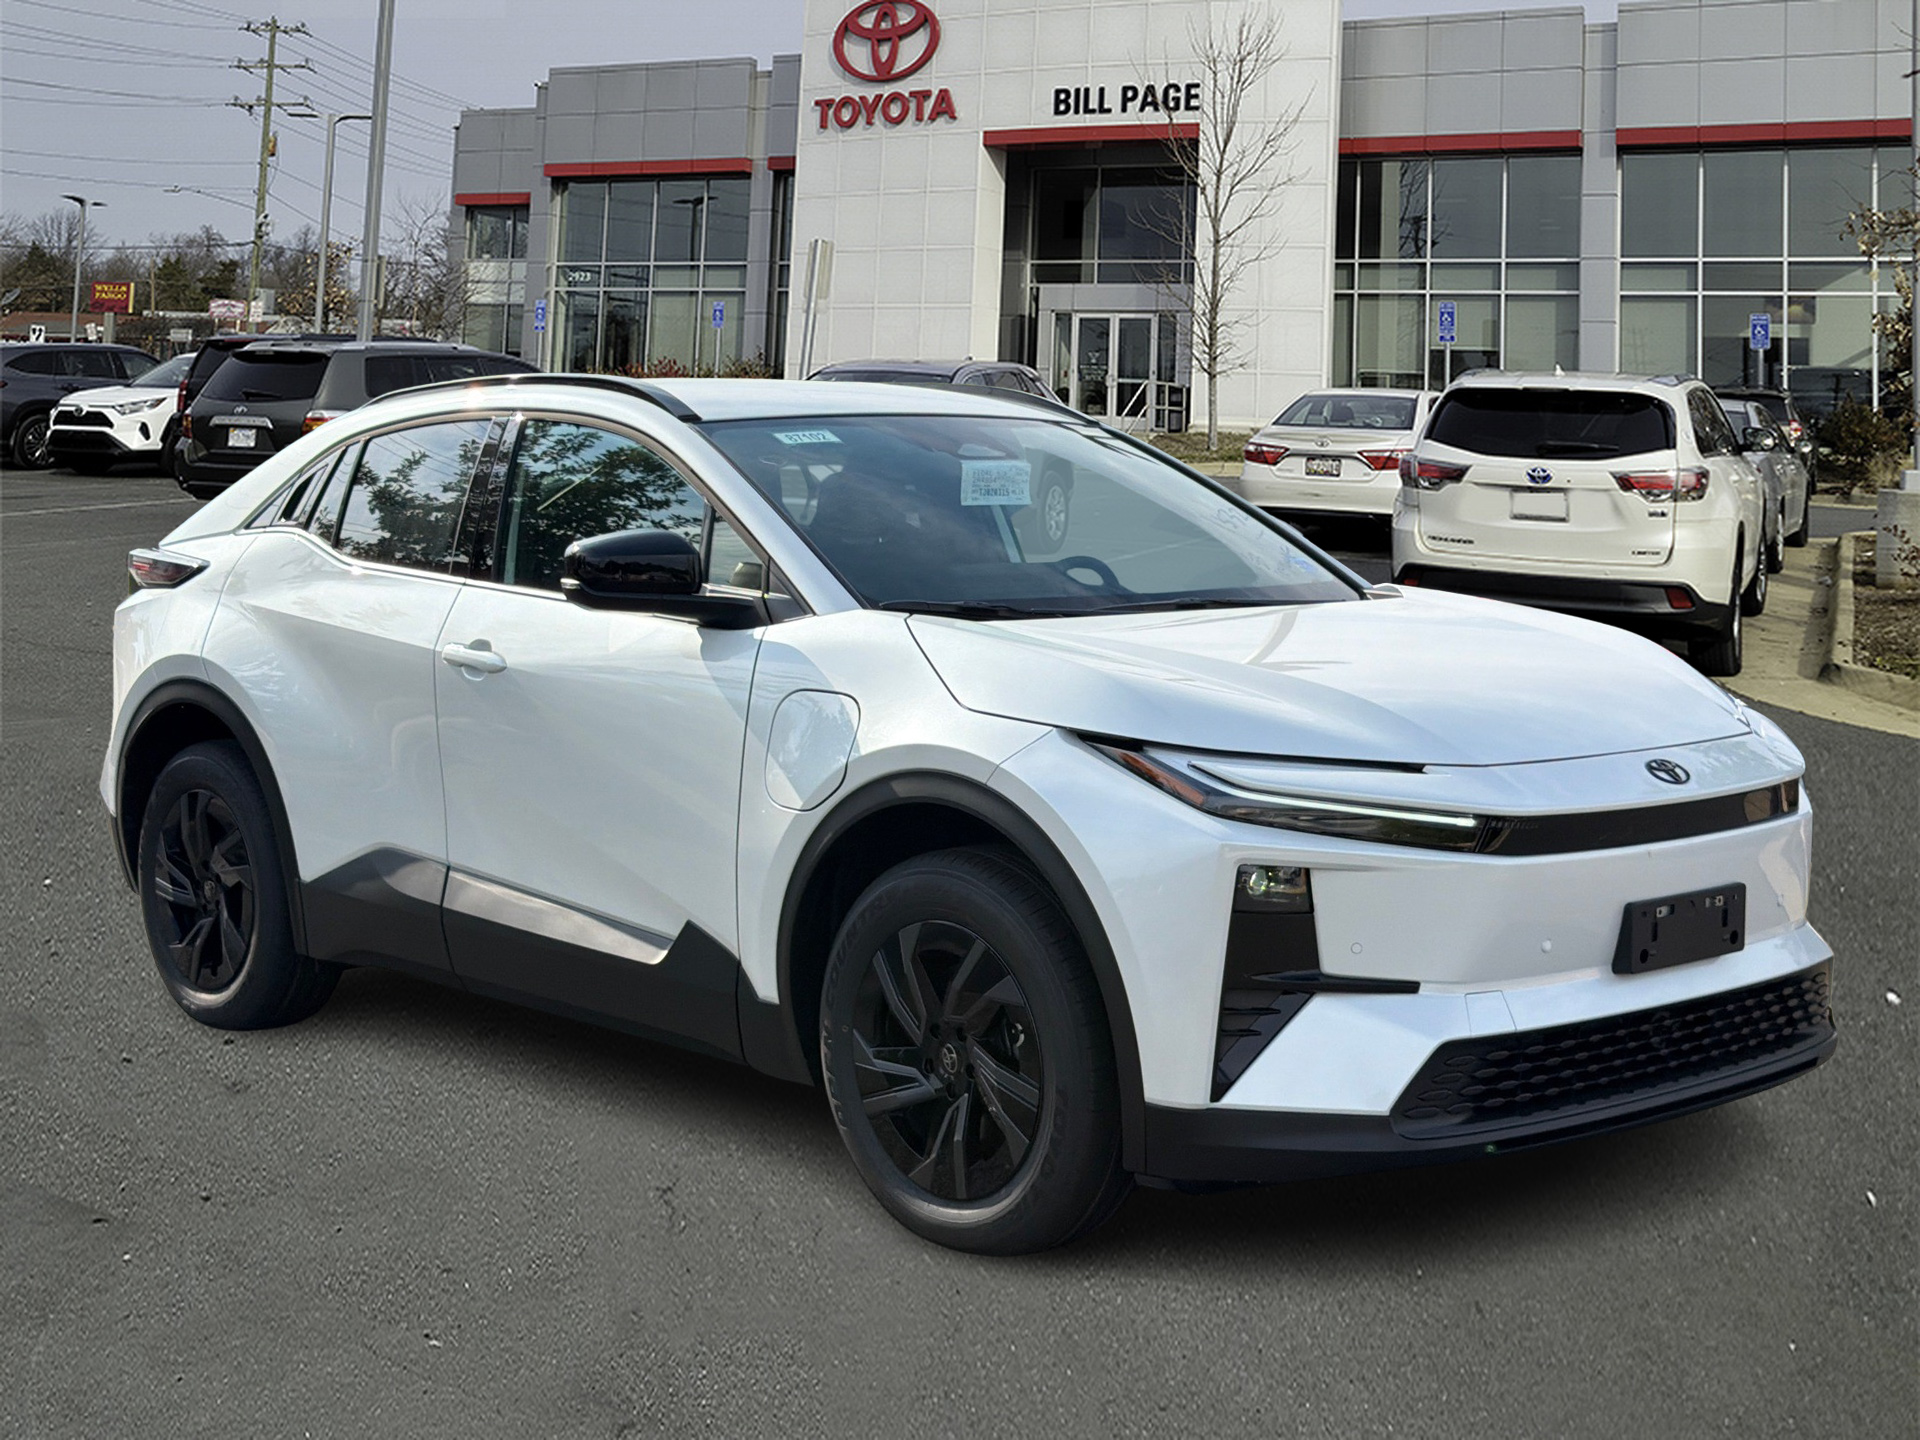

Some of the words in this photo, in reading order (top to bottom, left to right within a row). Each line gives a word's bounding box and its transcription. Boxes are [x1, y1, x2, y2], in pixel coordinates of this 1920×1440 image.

[814, 88, 958, 130] TOYOTA
[1053, 87, 1112, 116] BILL
[1120, 82, 1202, 114] PAGE
[94, 284, 127, 292] WELLS
[94, 292, 127, 300] FARGO
